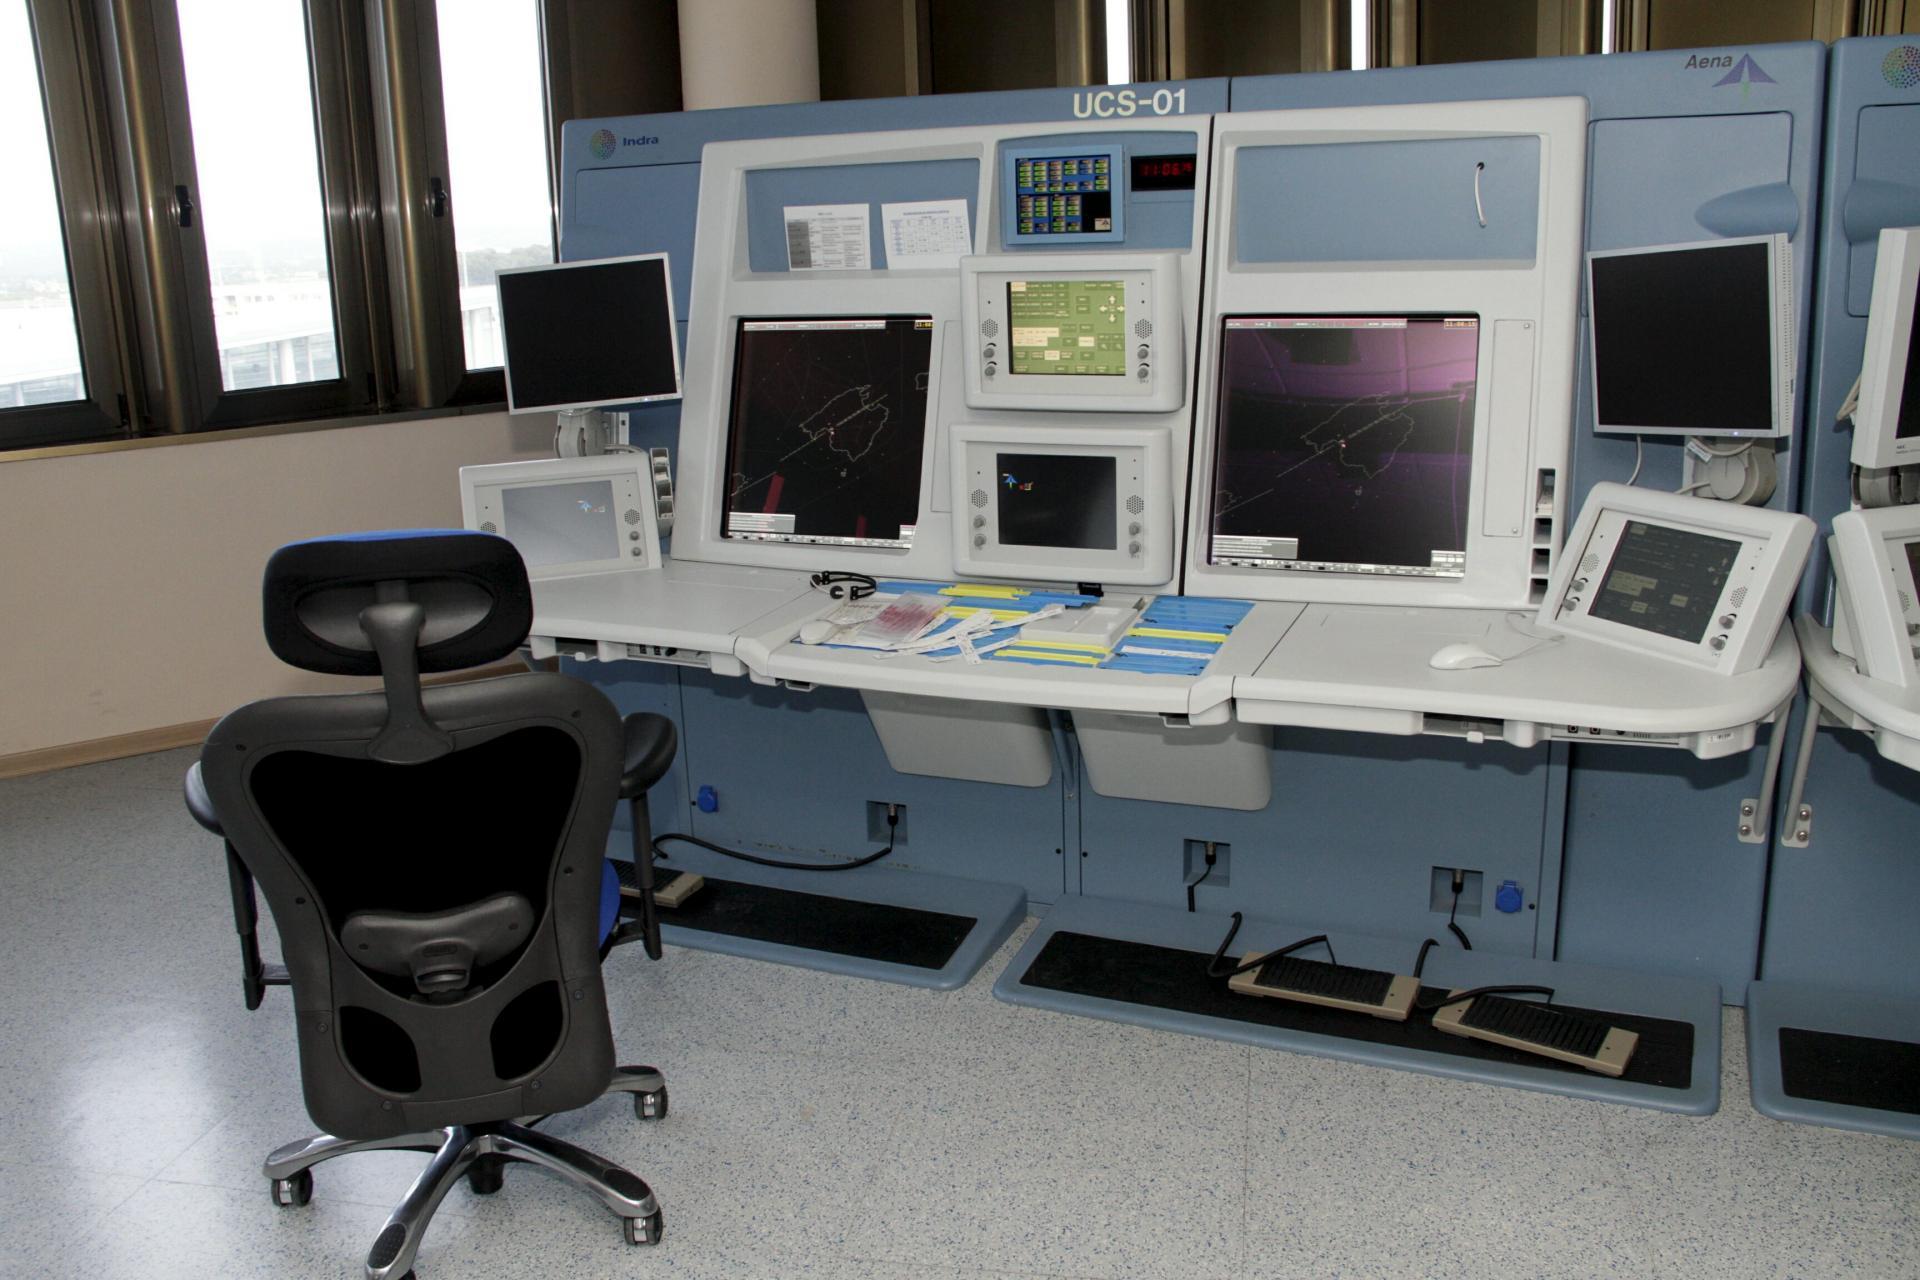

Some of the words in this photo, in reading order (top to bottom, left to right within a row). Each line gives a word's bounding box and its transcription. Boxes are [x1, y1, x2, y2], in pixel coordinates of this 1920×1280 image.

[1684, 54, 1733, 70] Aena
[1073, 88, 1186, 118] UCS-01
[623, 136, 659, 146] Indra
